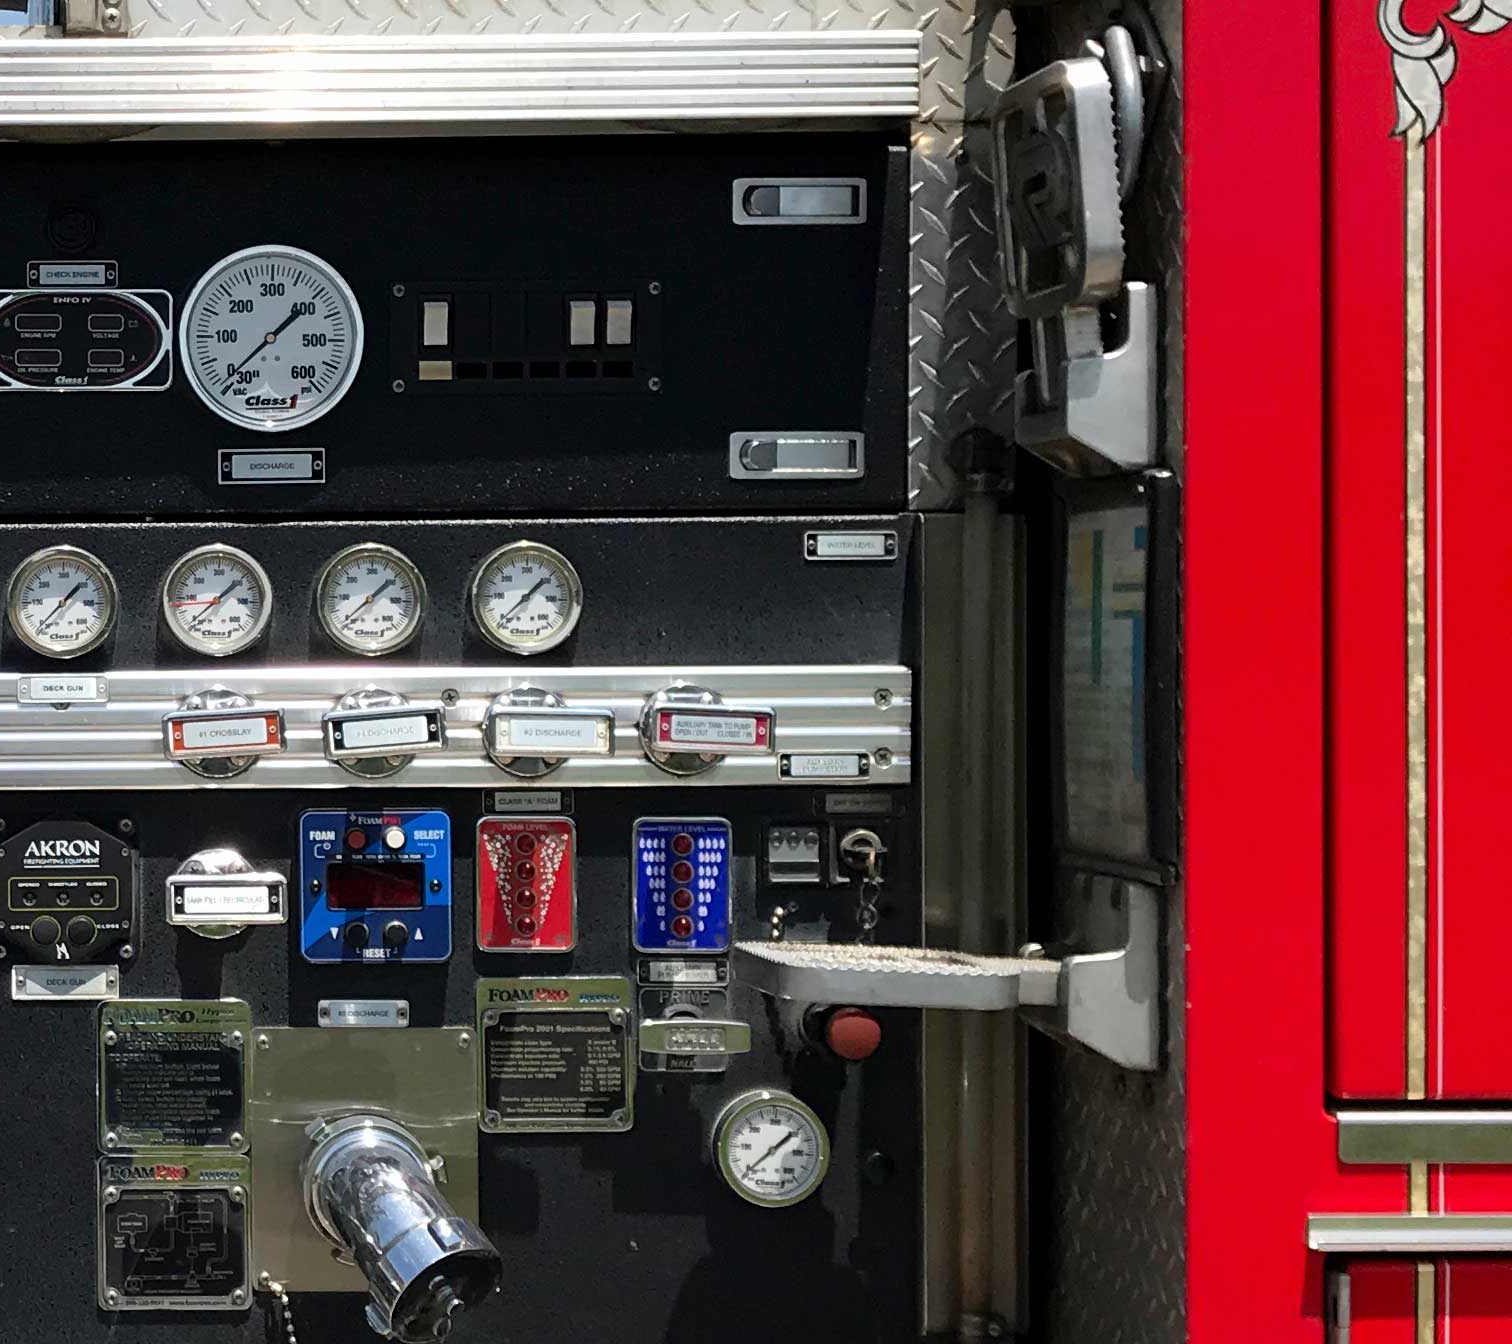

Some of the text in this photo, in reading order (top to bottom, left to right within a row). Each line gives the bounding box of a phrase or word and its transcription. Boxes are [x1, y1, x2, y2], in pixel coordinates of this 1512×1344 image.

[46, 270, 100, 279] CHECK ENGINE
[260, 283, 285, 297] 300
[229, 300, 254, 313] 200
[290, 302, 316, 315] 400
[215, 330, 237, 343] 100
[302, 333, 327, 347] 500
[291, 365, 316, 379] 600
[232, 387, 247, 396] VAC
[249, 462, 295, 470] DISCHARGE
[209, 728, 252, 737] CROSSLAY
[535, 729, 582, 737] DISCHARGE
[309, 831, 336, 841] FOAM
[413, 830, 445, 840] SELECT
[24, 840, 100, 856] AKRON
[362, 948, 391, 958] RESET
[46, 978, 86, 986] DECK GUN
[488, 988, 569, 1003] FOAMPRO
[659, 991, 710, 1004] PRIME
[556, 1025, 611, 1033] Specifications
[181, 1042, 221, 1051] MANUAL
[106, 1165, 190, 1181] FOAMPRO
